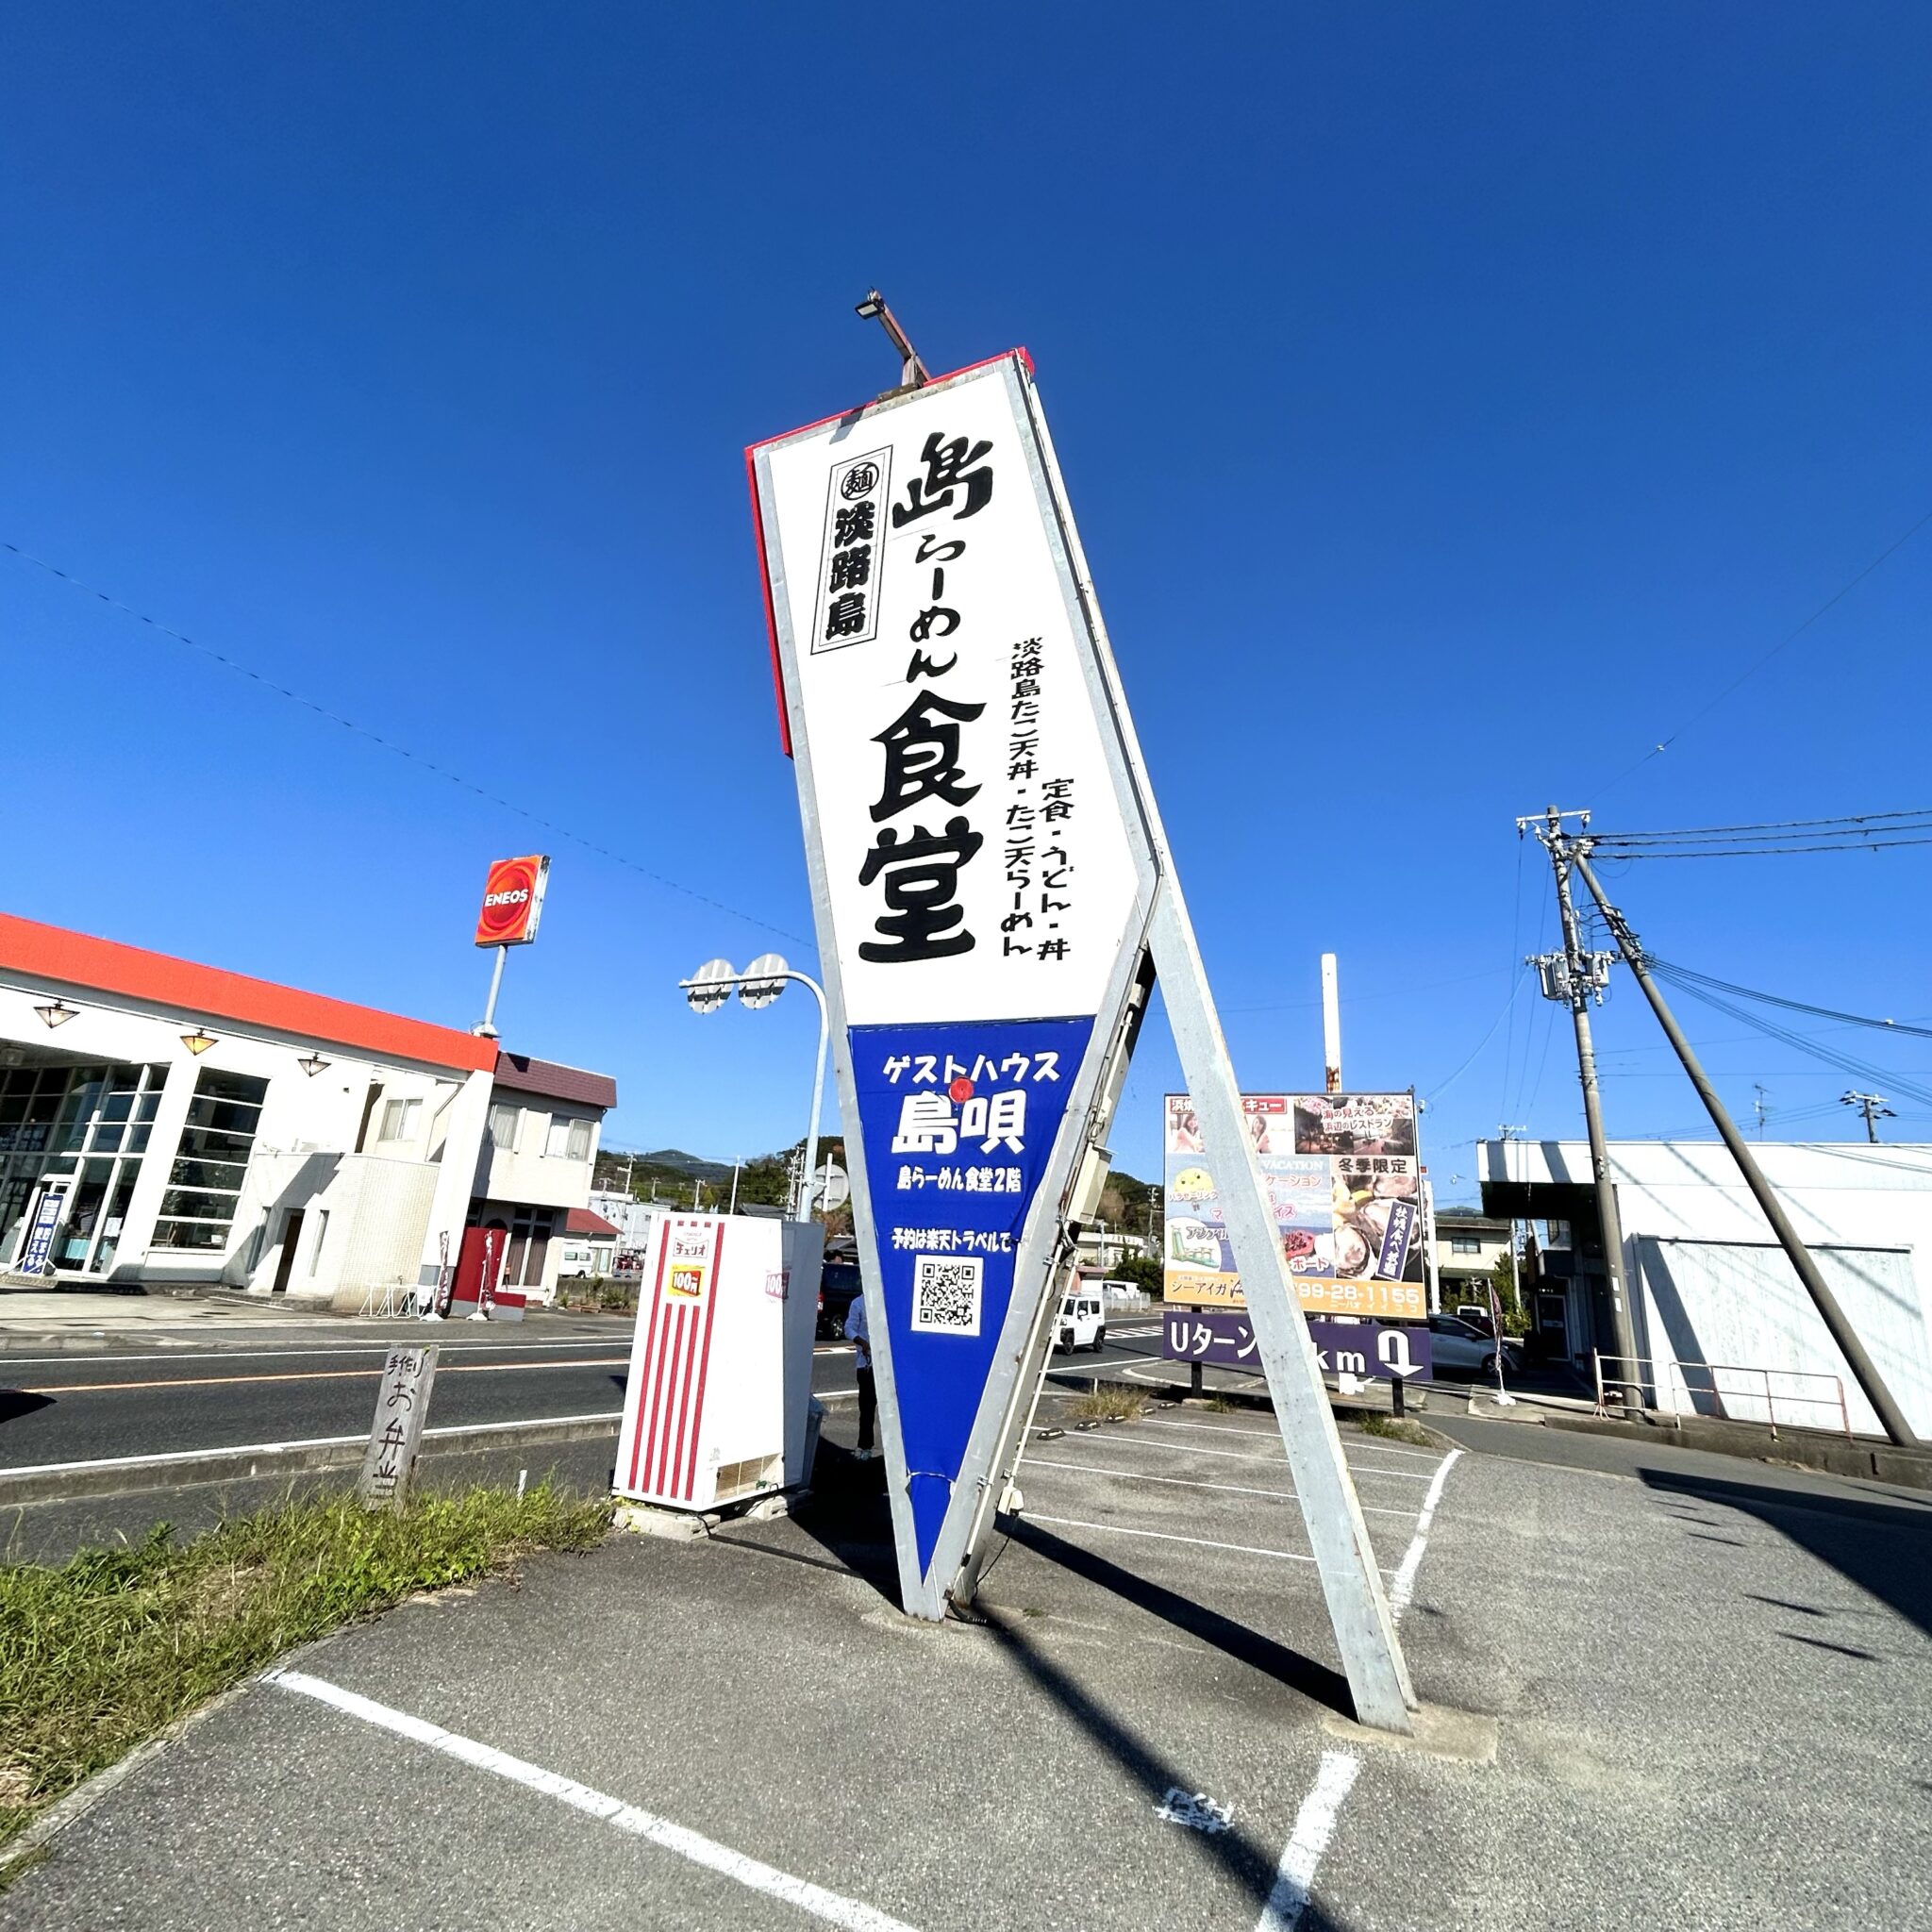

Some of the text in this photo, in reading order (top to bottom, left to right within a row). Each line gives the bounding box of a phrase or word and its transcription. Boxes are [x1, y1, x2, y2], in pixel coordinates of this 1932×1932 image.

[484, 889, 528, 907] ENEOS
[882, 1051, 1060, 1084] ゲストハウス
[891, 1089, 1027, 1155] 島唄
[897, 1165, 1021, 1192] 島らーめん食堂2階
[1339, 1158, 1407, 1174] 冬季限定
[675, 1241, 706, 1256] チェリオ
[891, 1227, 1012, 1253] 予約は楽天トラベルで
[1296, 1282, 1420, 1304] 99-28-1155
[1171, 1322, 1257, 1358] Uターン
